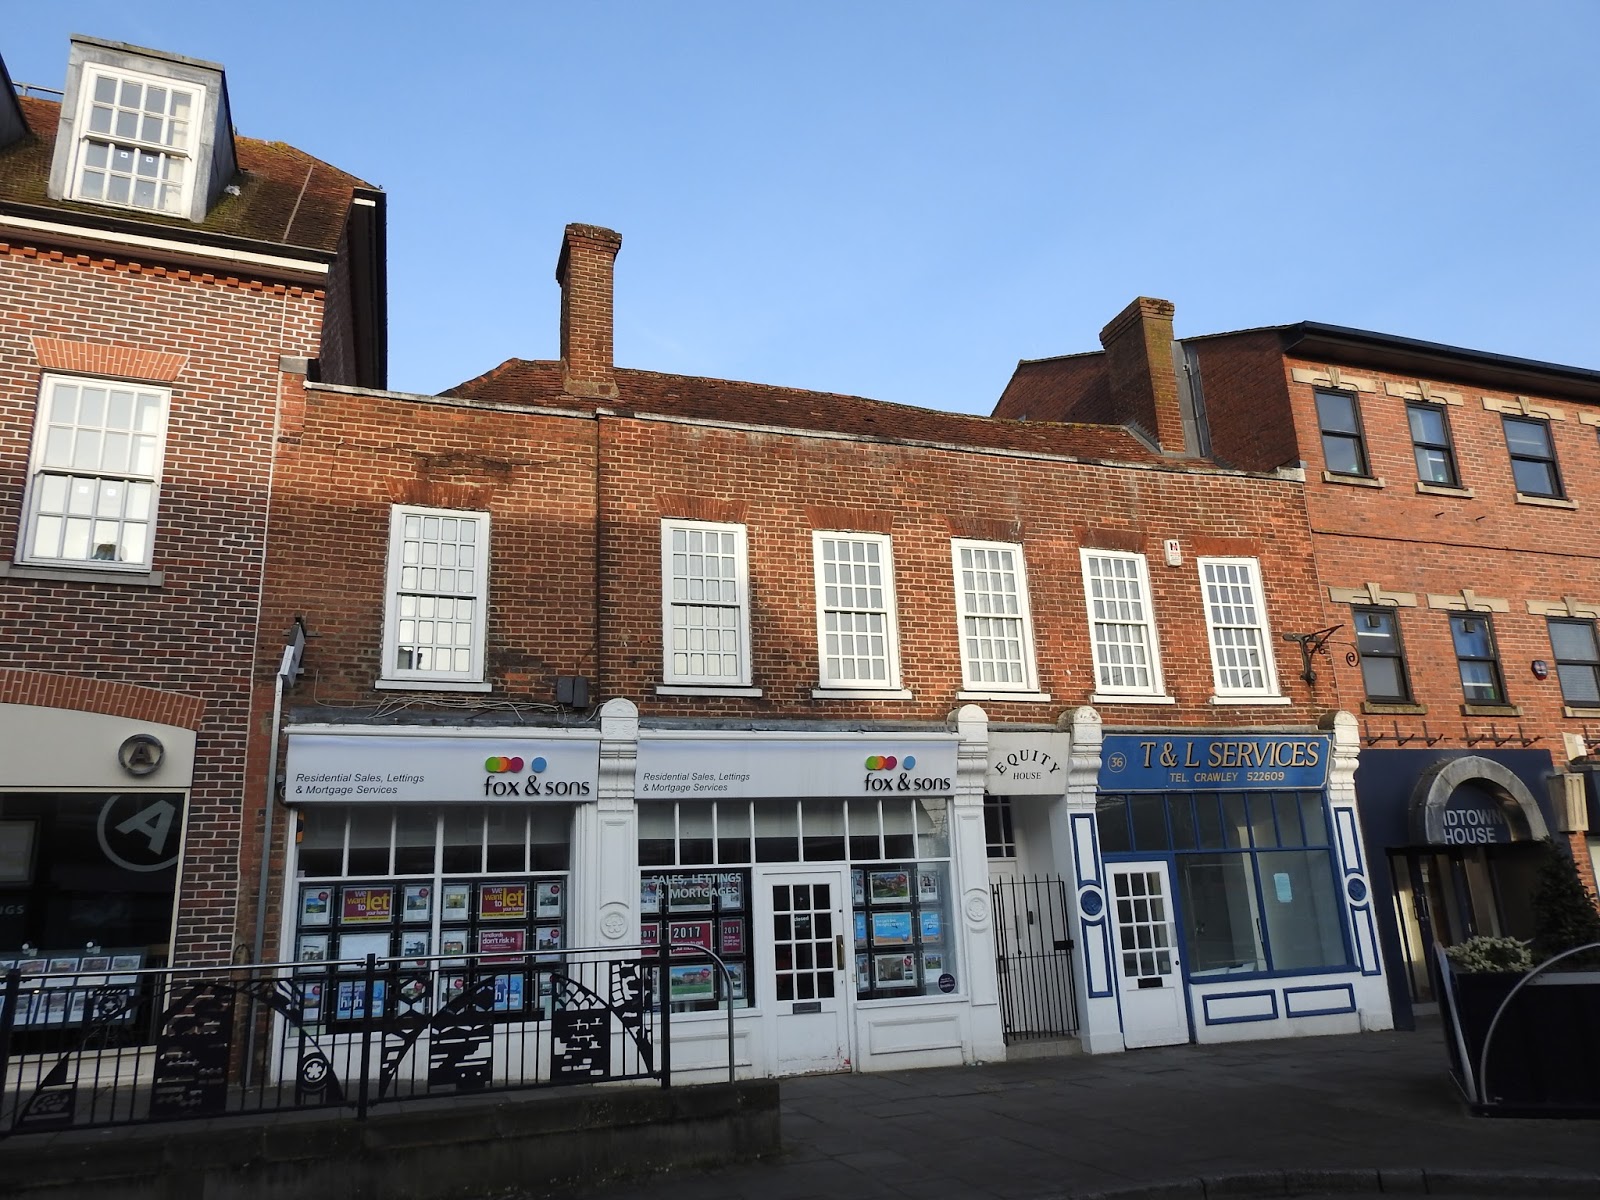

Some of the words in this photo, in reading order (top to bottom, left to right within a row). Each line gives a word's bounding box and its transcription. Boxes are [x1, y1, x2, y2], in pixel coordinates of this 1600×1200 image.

[1140, 742, 1157, 768] T
[1160, 741, 1178, 768] &
[1184, 742, 1200, 768] L
[1207, 741, 1320, 768] SERVICES
[994, 749, 1060, 776] EQUITY
[1110, 757, 1123, 768] 36
[295, 773, 352, 782] Residential
[354, 773, 384, 783] Sales,
[386, 773, 425, 784] Lettings
[642, 772, 689, 781] Residential
[691, 772, 716, 781] Sales,
[718, 772, 751, 782] Lettings
[864, 772, 894, 791] fox
[897, 772, 911, 791] &
[913, 777, 951, 791] sons
[1013, 772, 1041, 780] HOUSE
[1170, 772, 1189, 782] TEL.
[1194, 772, 1238, 782] CRAWLEY
[1246, 771, 1285, 781] 522609
[295, 785, 303, 794] &
[305, 785, 354, 796] Mortgage
[356, 785, 398, 794] Services
[484, 775, 520, 796] fox
[524, 774, 541, 796] &
[545, 781, 590, 796] sons
[642, 783, 649, 792] &
[651, 783, 691, 793] Mortgage
[693, 783, 728, 792] Services
[1443, 809, 1503, 826] IDTOWN
[114, 799, 176, 856] A
[1443, 827, 1497, 844] HOUSE
[651, 874, 687, 885] SALES,
[691, 873, 742, 884] LETTINGS
[502, 888, 524, 907] let
[656, 889, 665, 899] &
[669, 887, 738, 899] MORTGAGES
[366, 890, 390, 911] let
[673, 926, 700, 938] 2017
[724, 926, 739, 934] 2017
